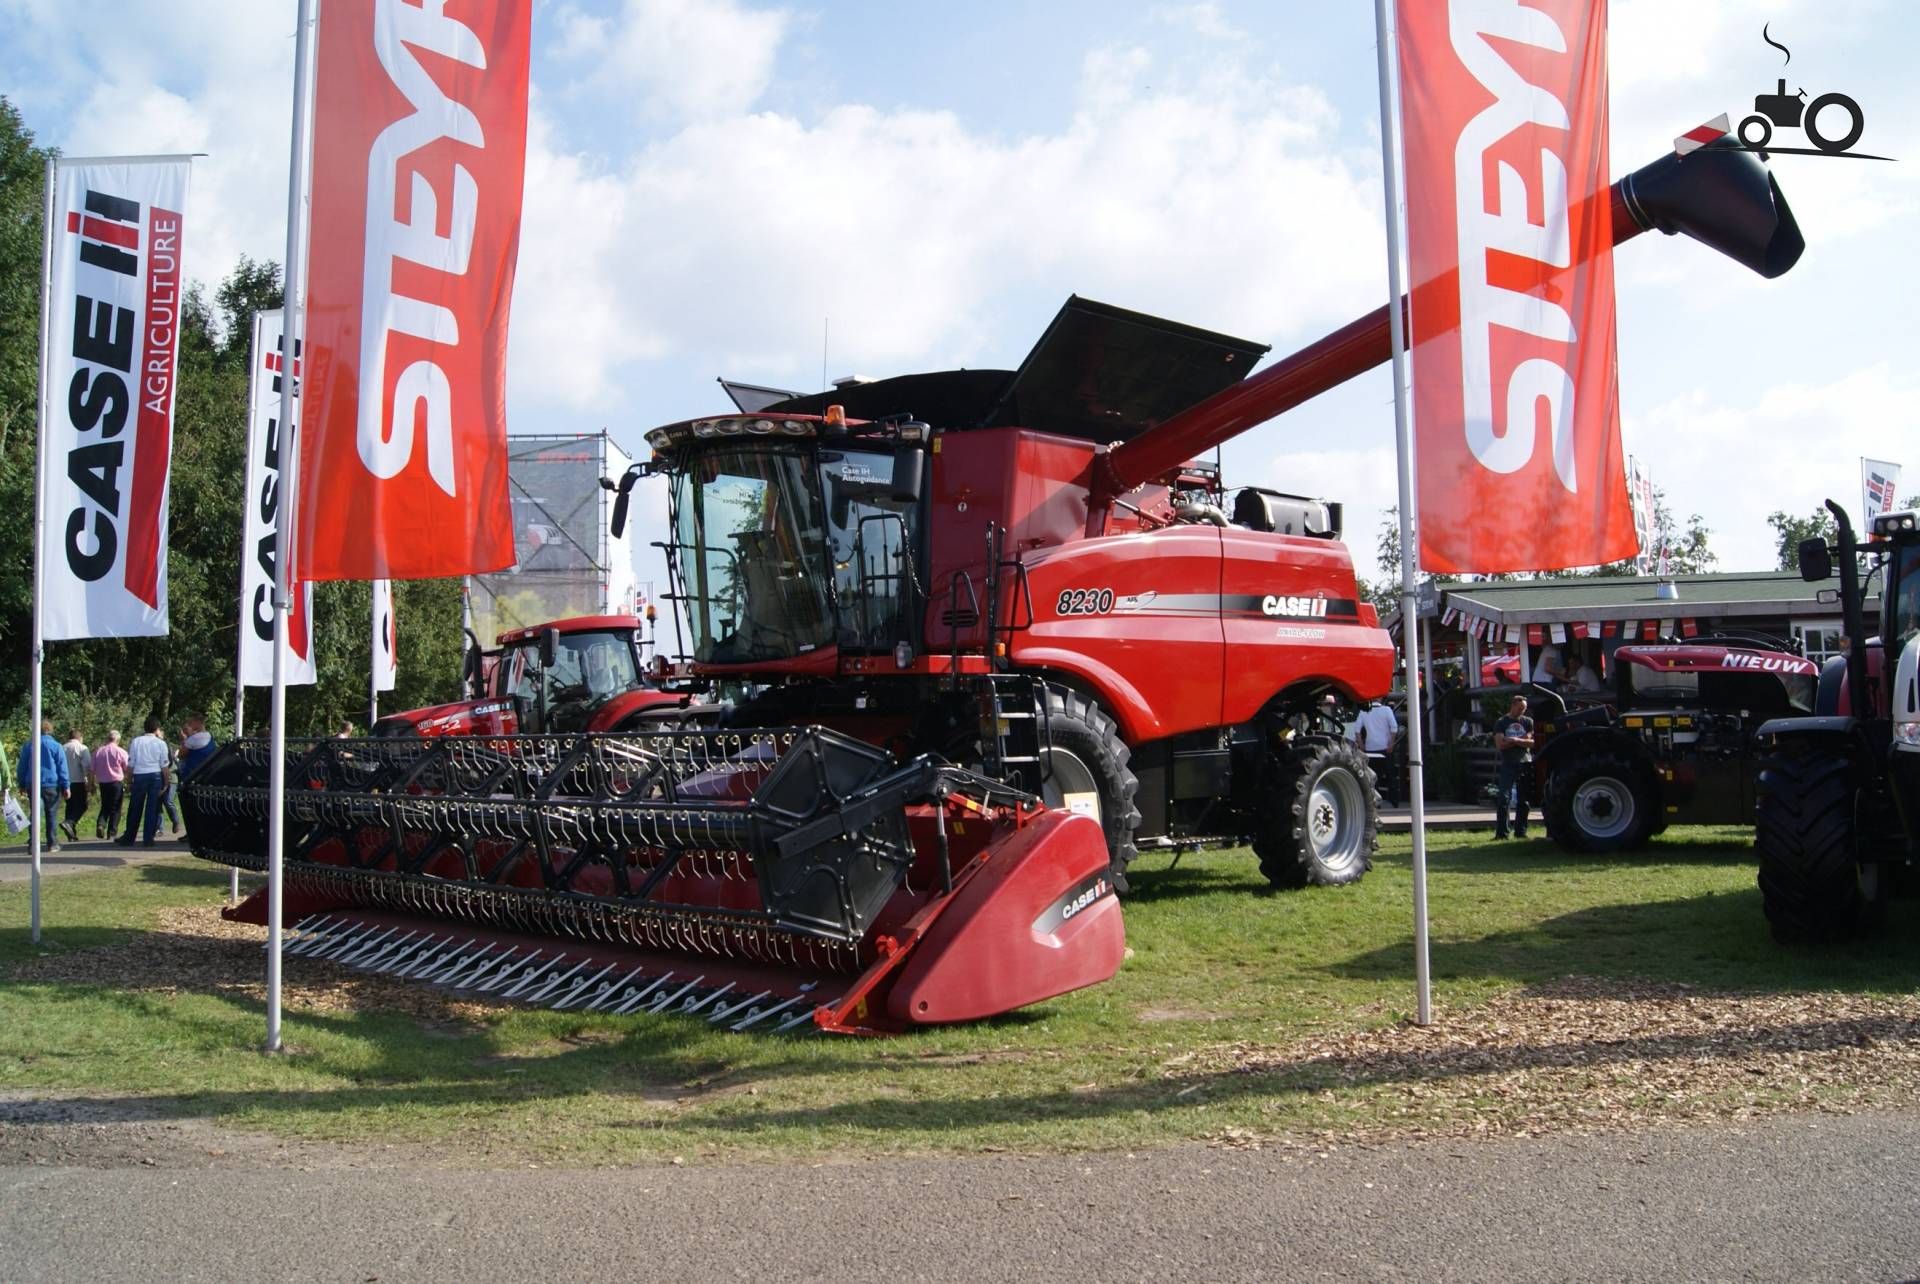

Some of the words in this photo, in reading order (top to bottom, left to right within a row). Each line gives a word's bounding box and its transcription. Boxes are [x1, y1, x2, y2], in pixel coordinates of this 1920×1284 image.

[140, 218, 177, 415] AGRICULTURE
[65, 296, 134, 582] CASE
[841, 466, 860, 475] Case
[861, 467, 871, 475] IH
[1057, 588, 1113, 616] 8230
[1262, 595, 1311, 617] CASE
[1721, 653, 1809, 674] NIEUW
[475, 703, 500, 715] CASE
[1062, 888, 1095, 919] CASE
